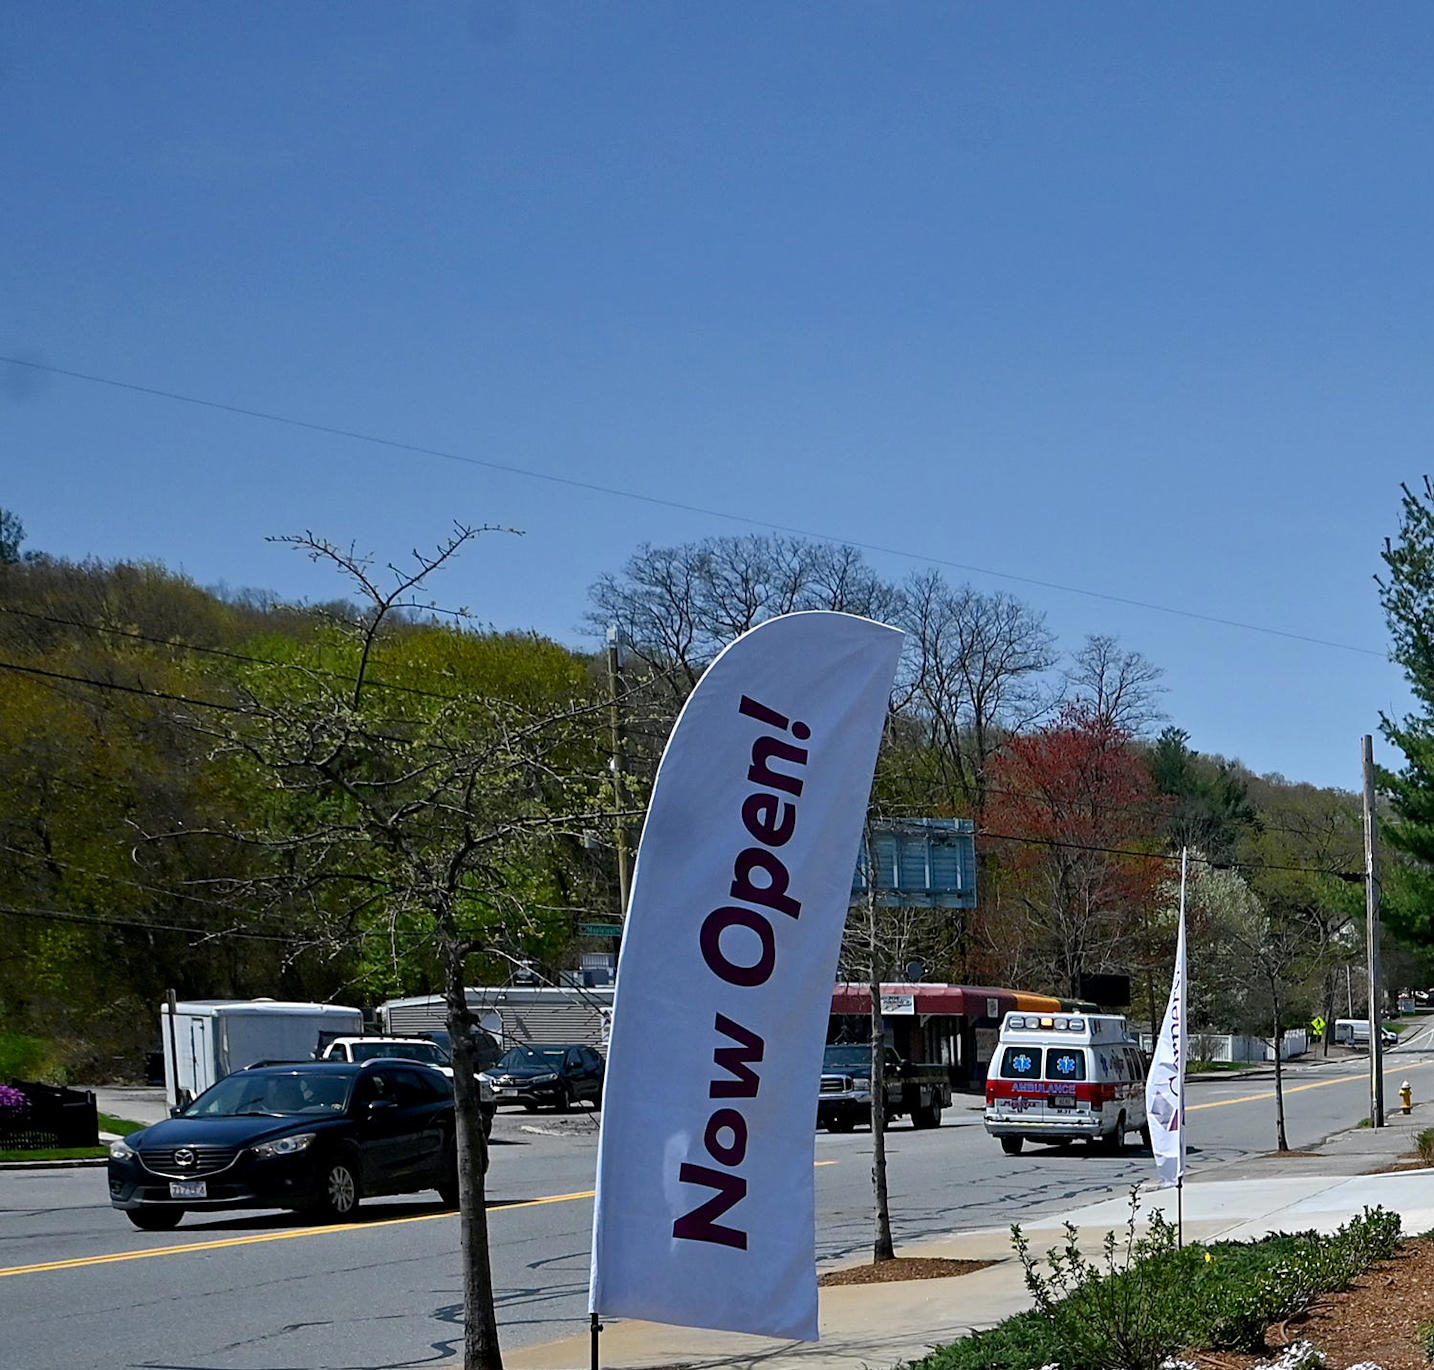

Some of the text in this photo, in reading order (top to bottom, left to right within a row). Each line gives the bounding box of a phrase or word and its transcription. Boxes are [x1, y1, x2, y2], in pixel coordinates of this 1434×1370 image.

[673, 694, 812, 1251] Now Open!
[1011, 1082, 1076, 1094] AMBULANCE
